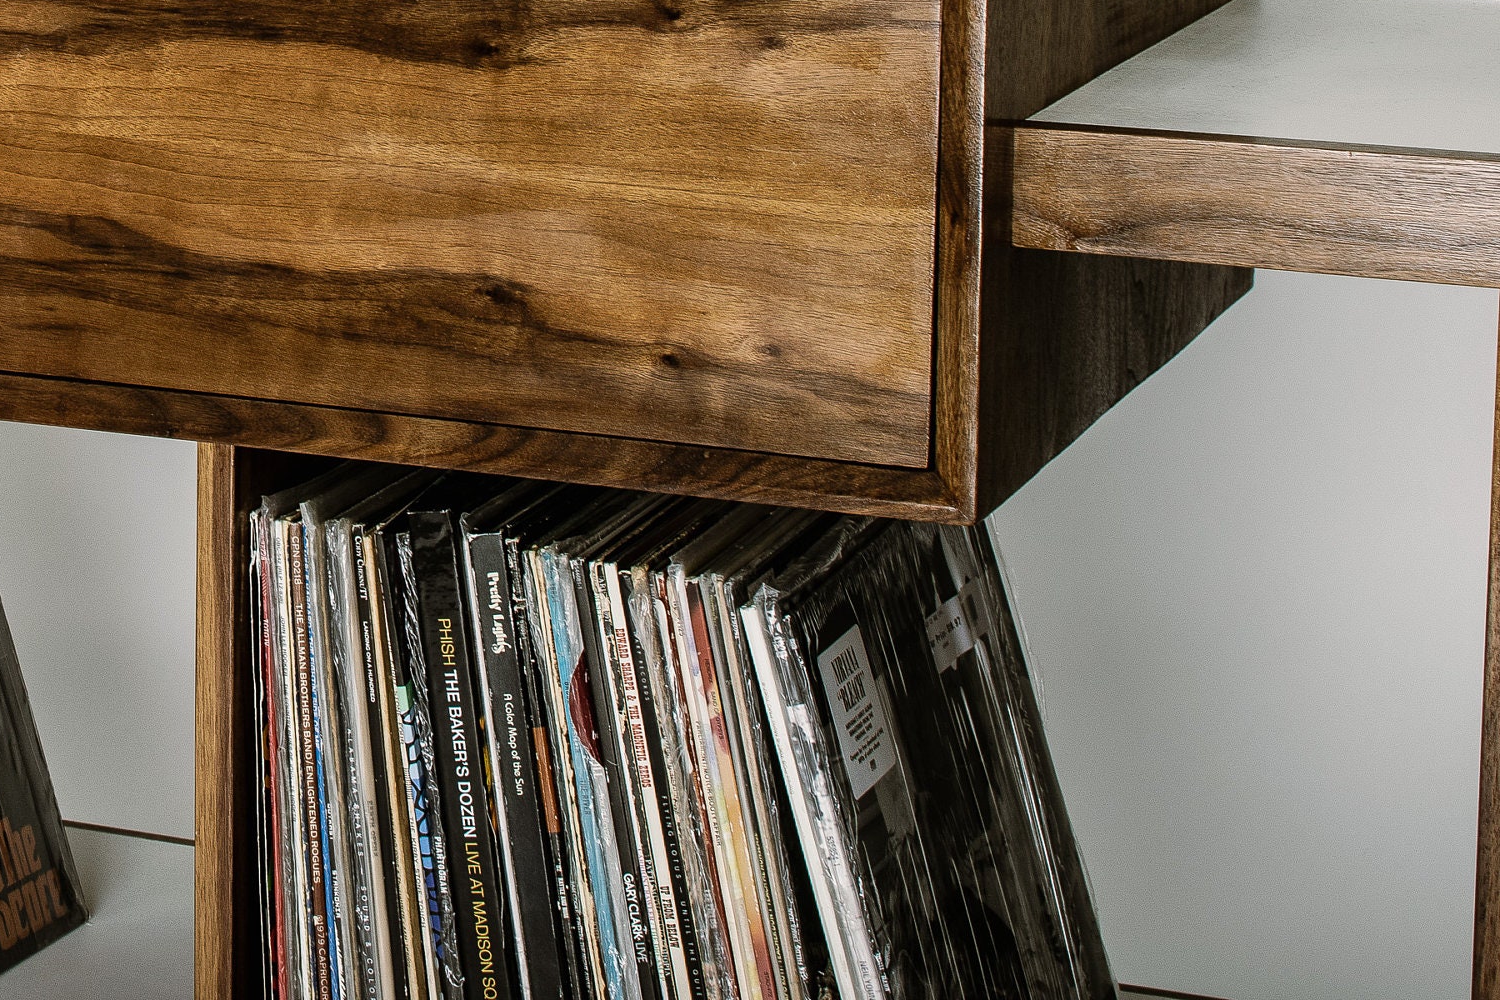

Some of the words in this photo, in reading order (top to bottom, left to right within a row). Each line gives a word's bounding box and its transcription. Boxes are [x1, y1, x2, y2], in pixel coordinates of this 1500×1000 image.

[290, 535, 301, 558] CPN
[292, 559, 303, 585] 0218
[483, 570, 503, 612] Pretty
[278, 615, 286, 636] JOHN
[294, 602, 304, 624] THE
[296, 625, 307, 669] ALLMAN
[436, 616, 457, 666] PHISH
[486, 612, 512, 655] Lights
[614, 626, 629, 660] EDWARD
[280, 648, 288, 678] HOOKER
[361, 620, 370, 651] LANDING
[366, 668, 376, 703] HUNDRED
[620, 661, 634, 692] SHARPE
[703, 657, 714, 684] HENDRIX
[831, 645, 860, 687] NIRVANA
[442, 668, 461, 704] THE
[636, 659, 650, 702] RECORDS
[299, 671, 311, 728] BROTHERS
[502, 691, 512, 701] A
[626, 693, 637, 702] &
[709, 689, 719, 708] BAND
[503, 701, 515, 726] Color
[628, 703, 640, 721] THE
[712, 707, 720, 716] OF
[446, 704, 471, 778] BAKER'S
[505, 726, 518, 749] Map
[631, 722, 647, 763] MAGNETIC
[714, 715, 725, 740] GYPSYS
[344, 727, 359, 794] ALABAMA
[509, 748, 520, 761] of
[511, 760, 523, 777] the
[302, 729, 318, 838] BAND/ENLIGHTENED
[513, 776, 525, 796] Sun
[638, 763, 652, 790] ZEROS
[456, 779, 478, 839] DOZEN
[580, 793, 592, 815] RIVER
[351, 802, 365, 858] SHAKES
[408, 816, 416, 830] THE
[660, 794, 674, 837] FLYING
[668, 842, 682, 880] LOTUS
[309, 839, 321, 884] ROGUES
[433, 835, 448, 894] PHANTOGRAM
[463, 840, 482, 876] LIVE
[643, 858, 655, 884] PATTI
[331, 868, 341, 919] STANKONIA
[468, 875, 485, 899] AT
[622, 871, 638, 904] GARY
[659, 884, 671, 896] UP
[359, 885, 371, 932] SOUND
[365, 940, 373, 948] &
[627, 902, 644, 938] CLARK
[661, 896, 675, 921] FROM
[471, 898, 495, 974] MADISON
[665, 921, 680, 950] BELOW
[678, 899, 692, 935] UNTIL
[686, 940, 696, 962] THE
[634, 940, 648, 965] LIVE
[858, 959, 870, 978] NEIL
